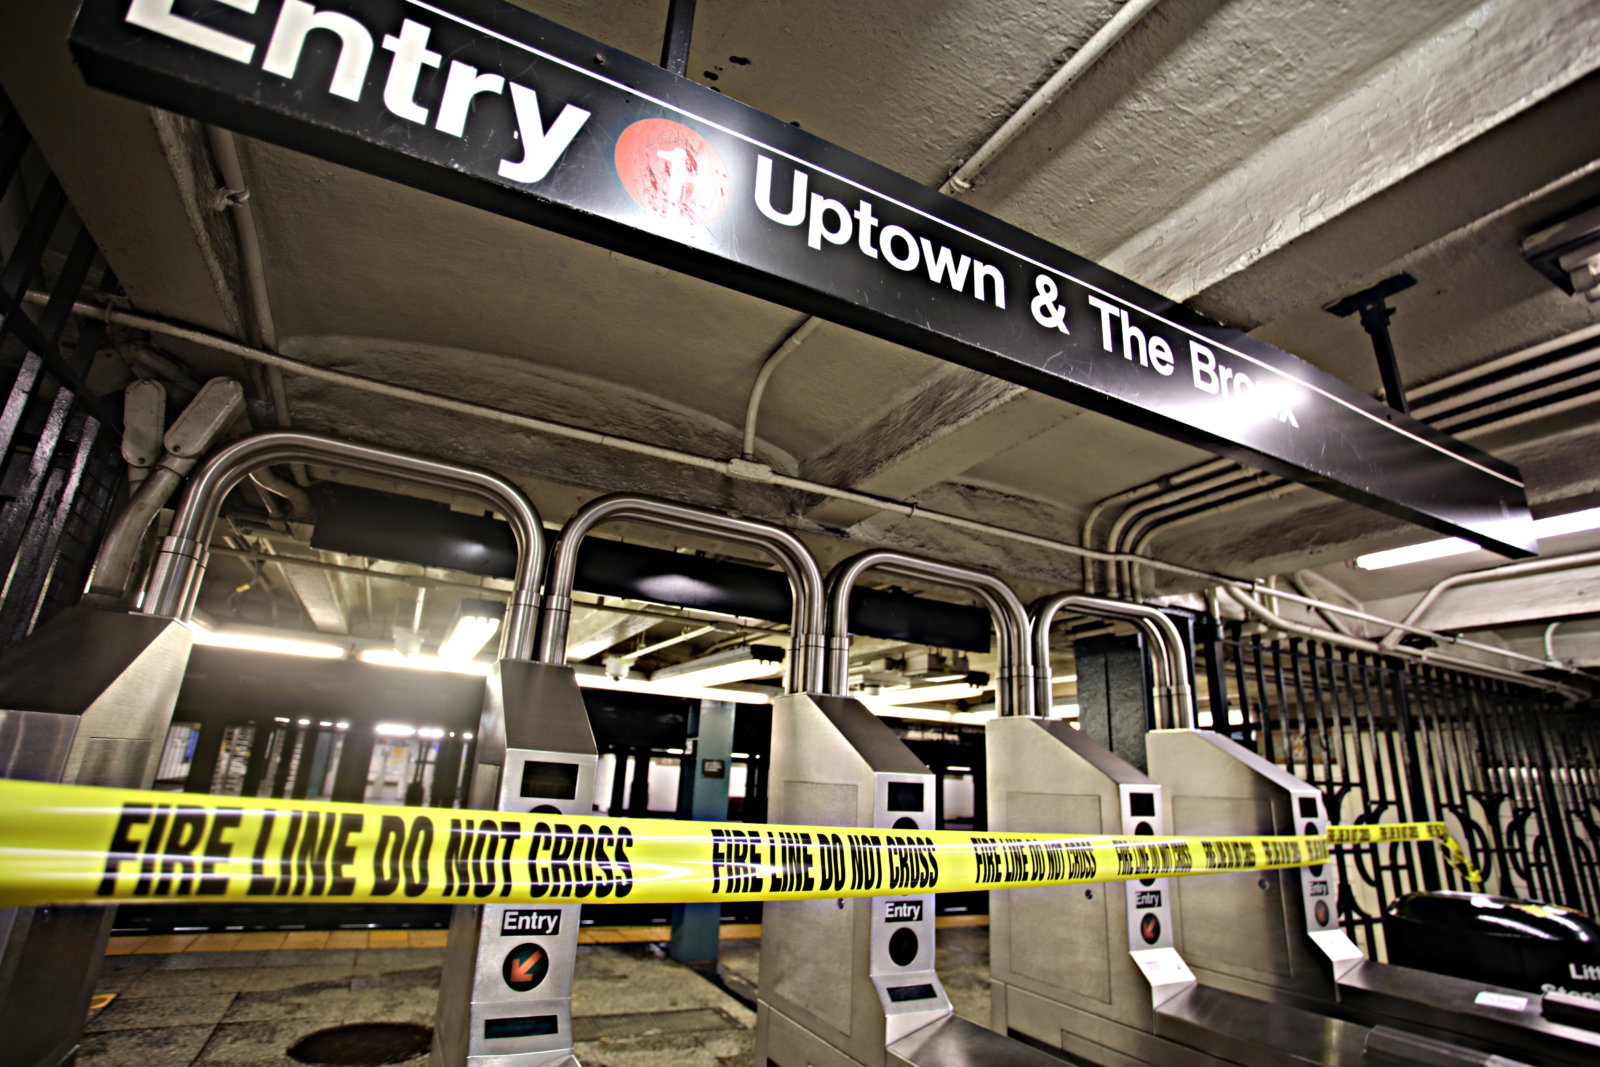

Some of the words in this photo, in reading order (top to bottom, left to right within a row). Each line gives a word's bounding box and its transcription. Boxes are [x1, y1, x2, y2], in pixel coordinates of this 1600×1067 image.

[125, 0, 592, 184] Entry
[754, 154, 1006, 309] Uptown
[1030, 274, 1070, 335] &
[1088, 295, 1175, 376] The
[1189, 339, 1300, 429] Brox
[97, 803, 244, 896] FIRE
[246, 809, 364, 896] LINE
[369, 814, 434, 897] DO
[441, 819, 521, 897] NOT
[528, 822, 634, 898] CROSS
[711, 829, 763, 893] FIRE
[767, 831, 815, 892] LINE
[817, 833, 846, 891] DO
[847, 834, 882, 890] NOT
[885, 835, 939, 889] CROSS
[970, 837, 1002, 883] FIRE
[998, 838, 1029, 882] LINE
[1025, 839, 1045, 881] DO
[1043, 840, 1065, 880] NOT
[1063, 841, 1097, 880] CROSS
[885, 902, 922, 920] Entry
[1136, 891, 1160, 907] Entry
[503, 911, 559, 935] Entry
